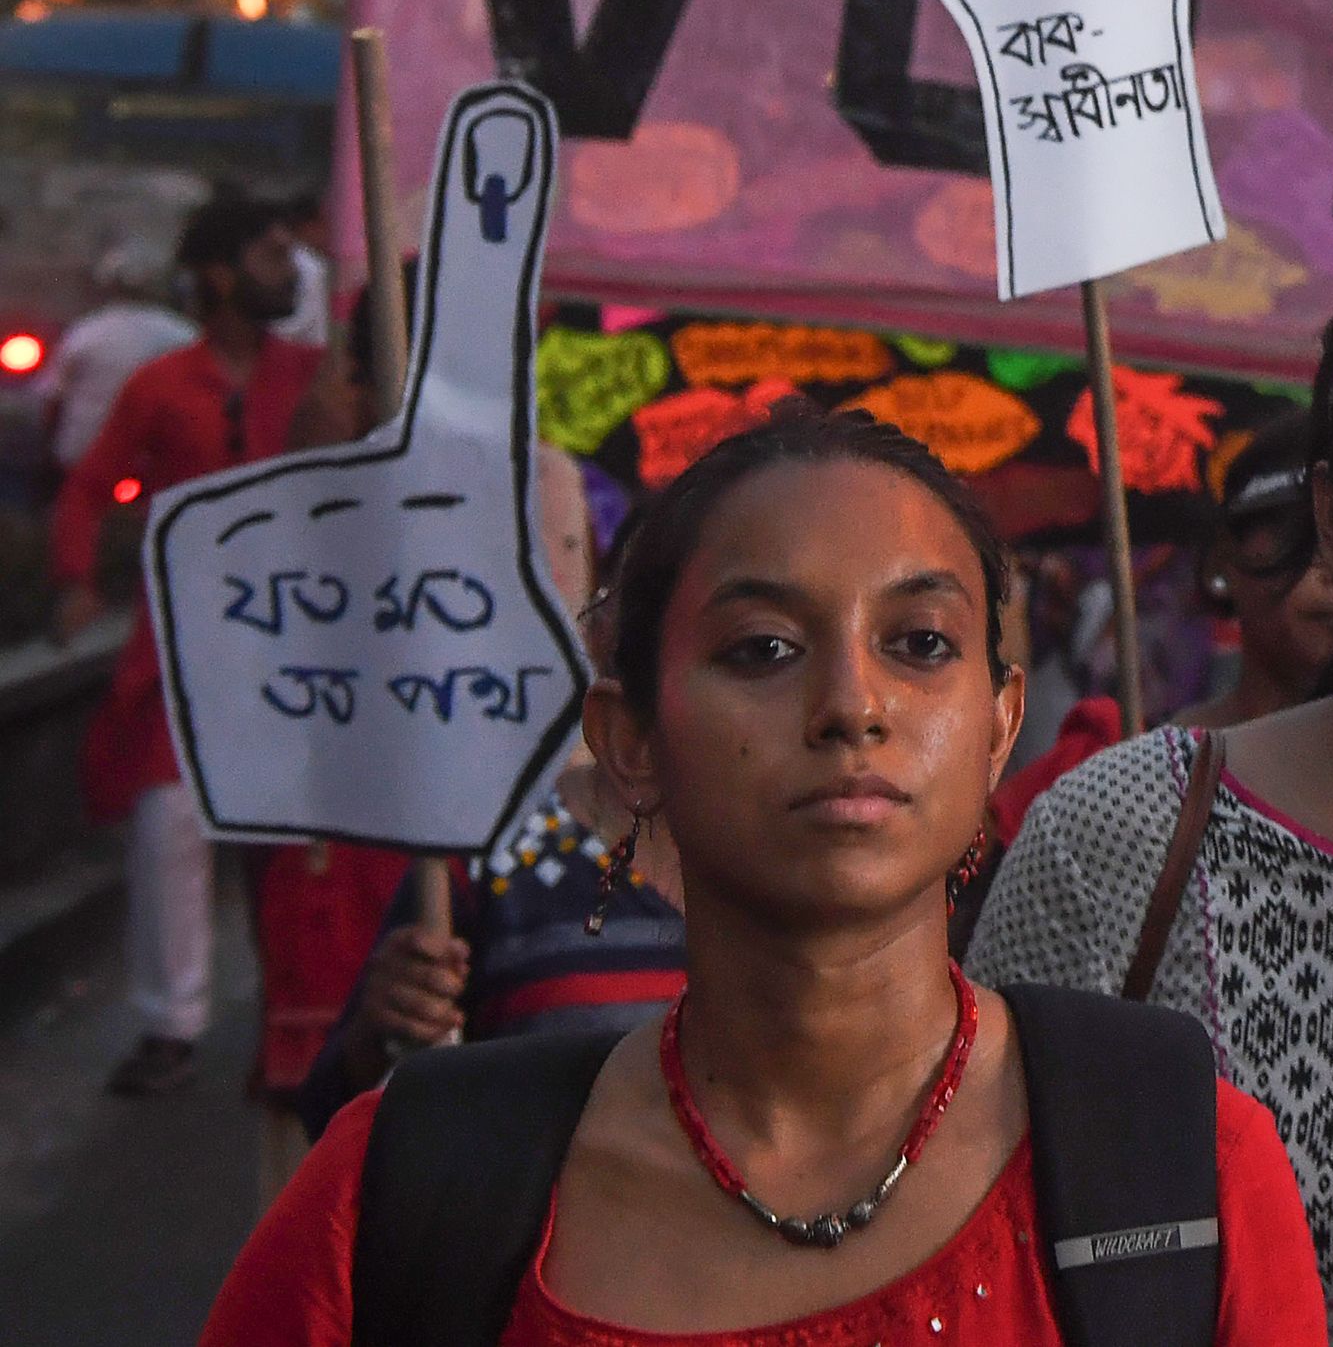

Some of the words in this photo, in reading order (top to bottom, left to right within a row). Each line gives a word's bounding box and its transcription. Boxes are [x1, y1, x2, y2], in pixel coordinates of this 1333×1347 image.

[1010, 63, 1182, 142] স্বাধীনতা
[224, 568, 348, 635] যত
[373, 568, 494, 633] মত
[1094, 1227, 1174, 1259] WILDCRAFT
